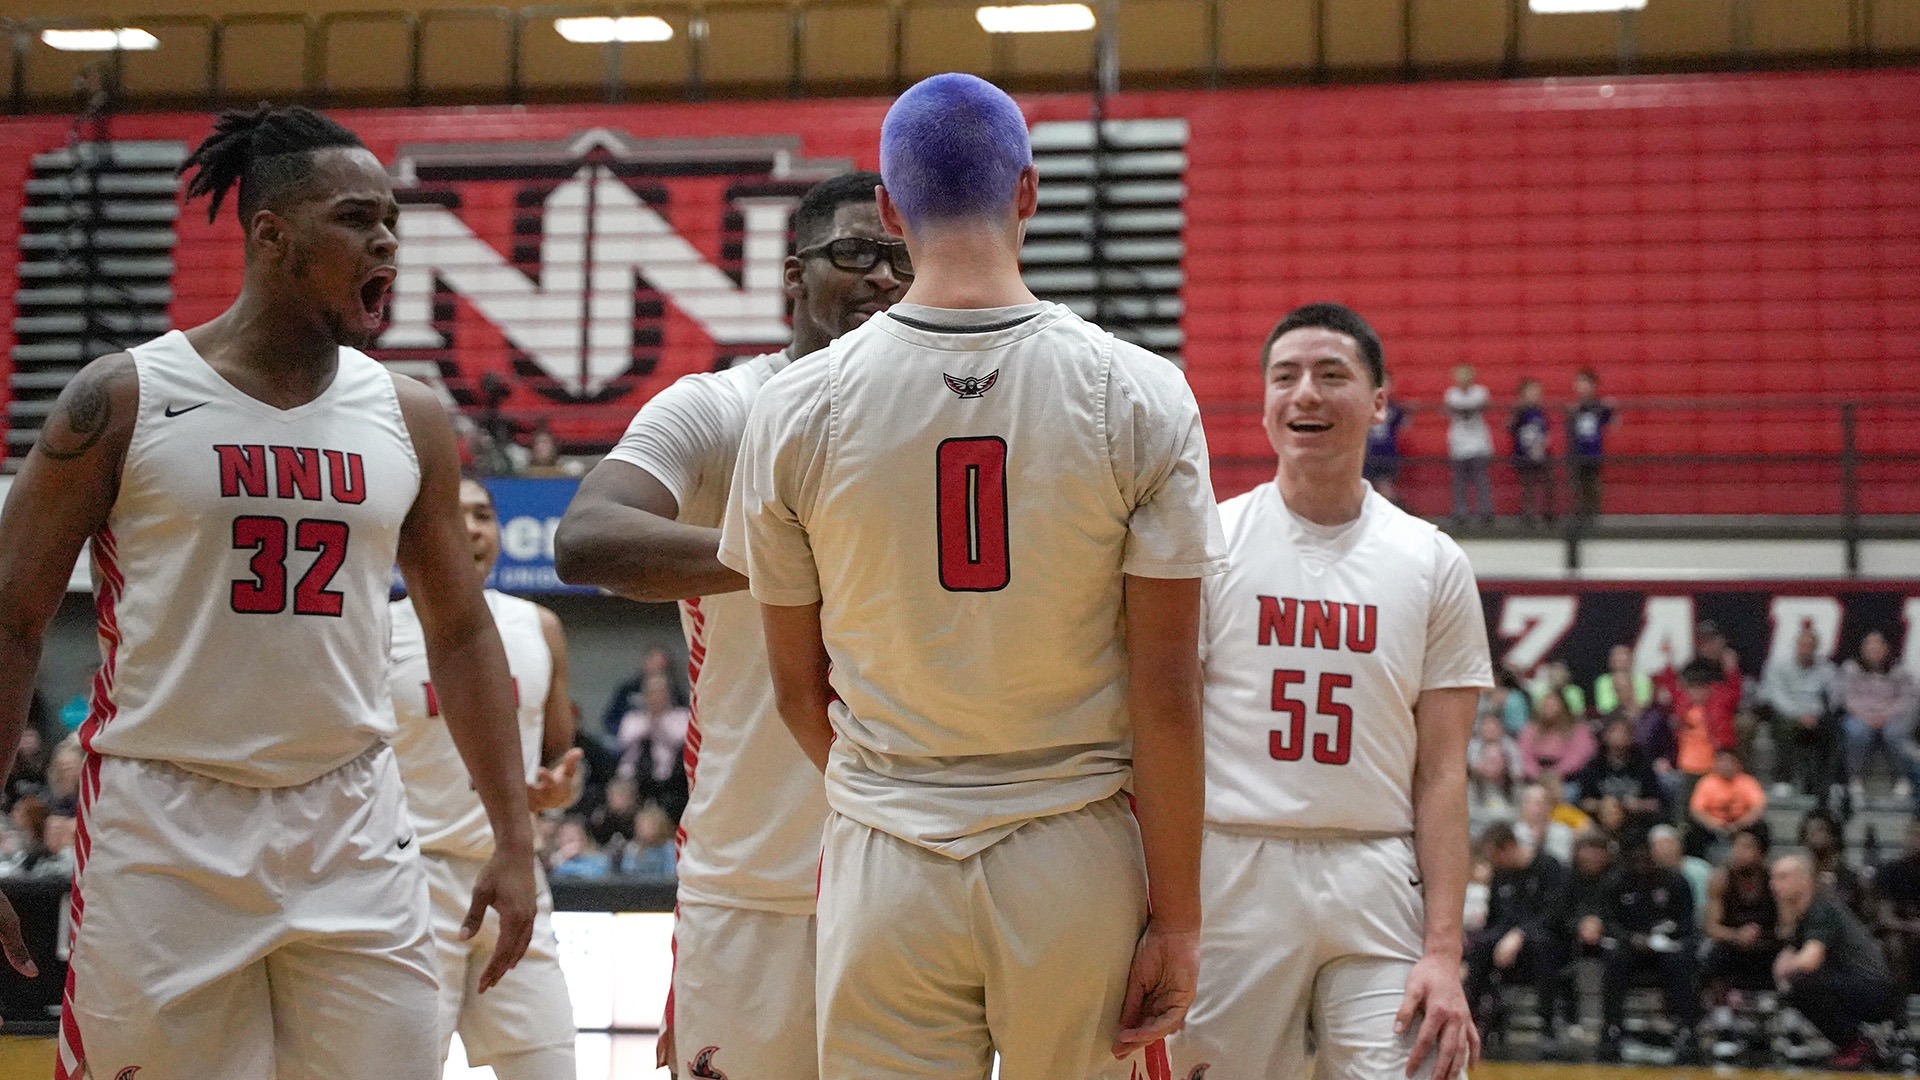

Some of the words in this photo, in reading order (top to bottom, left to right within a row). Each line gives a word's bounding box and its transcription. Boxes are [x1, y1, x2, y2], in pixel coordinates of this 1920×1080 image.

[213, 444, 367, 505] NNU
[936, 435, 1011, 592] 0
[231, 514, 349, 617] 32
[1257, 594, 1378, 653] NNU
[1269, 668, 1353, 765] 55
